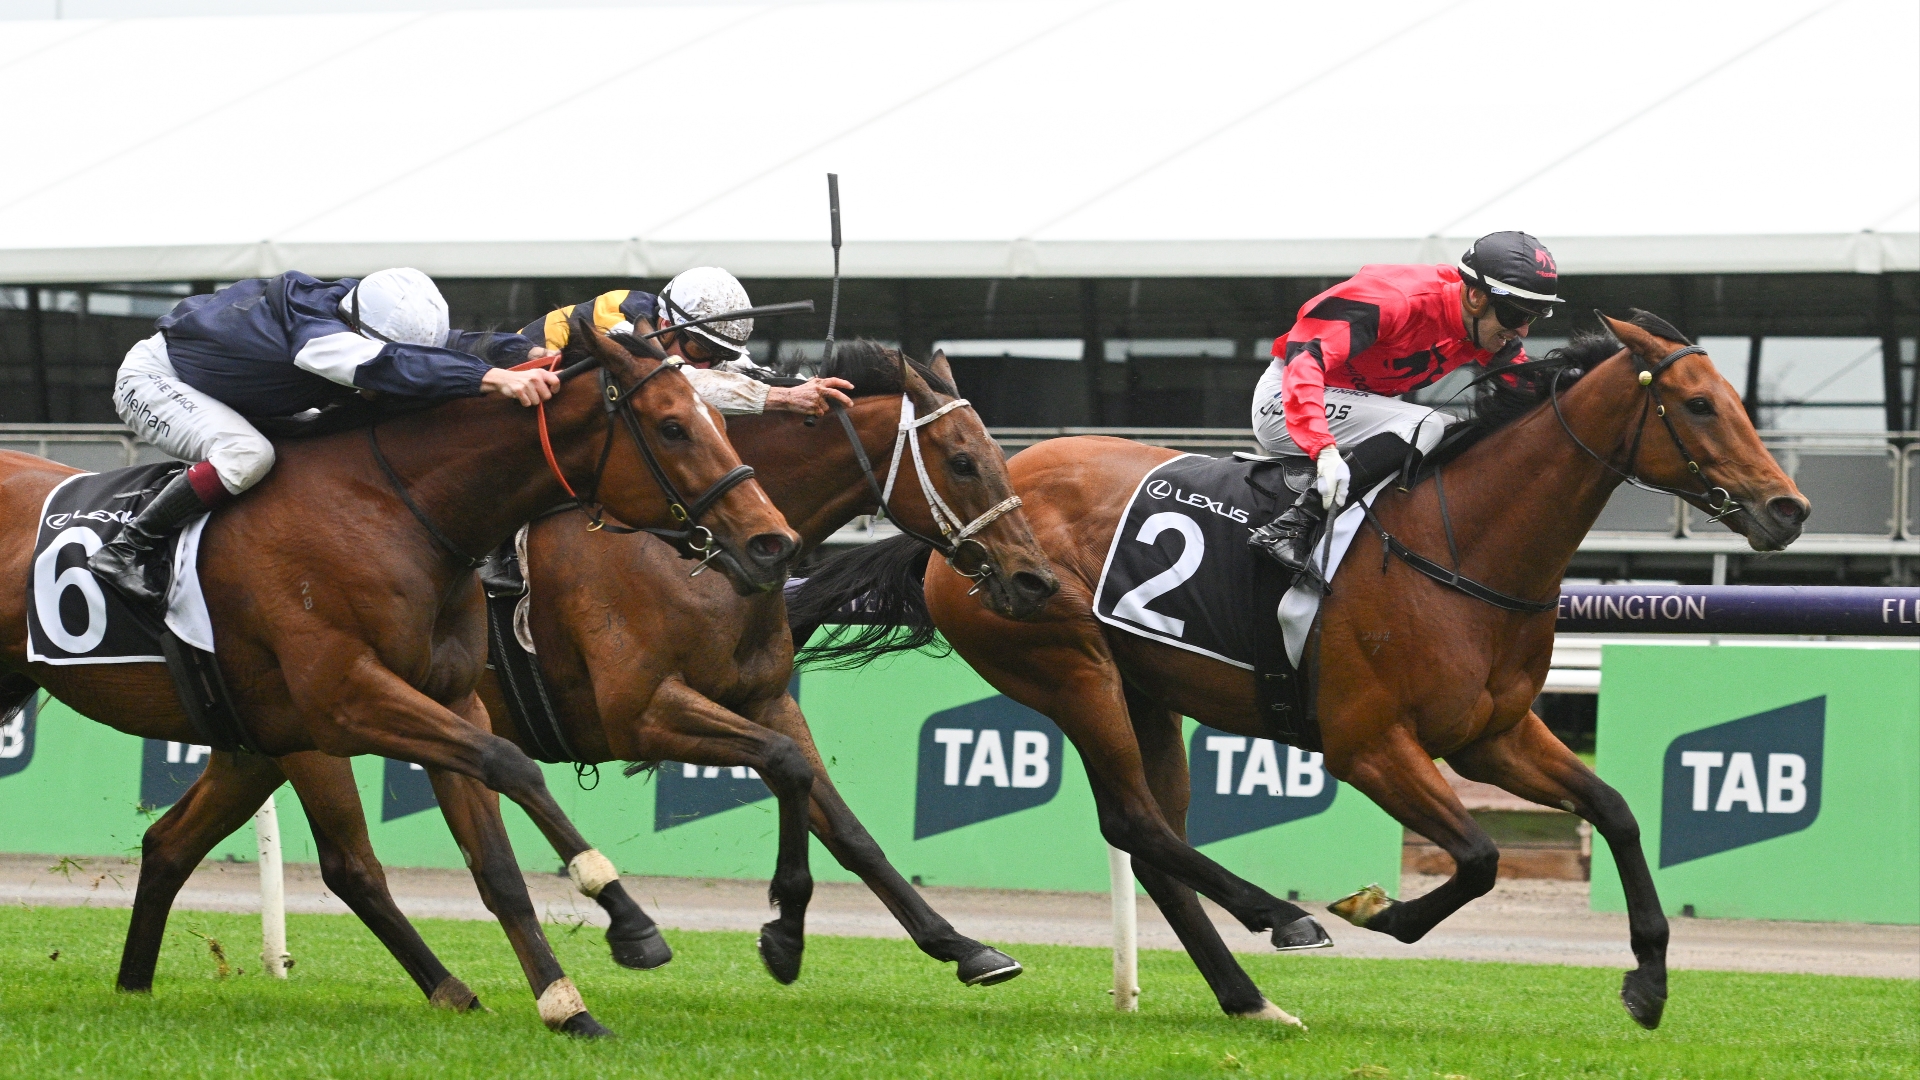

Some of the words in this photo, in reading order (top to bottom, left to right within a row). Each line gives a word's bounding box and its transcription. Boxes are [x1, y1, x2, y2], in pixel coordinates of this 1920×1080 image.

[1175, 488, 1250, 524] LEXUS
[33, 526, 108, 654] 6
[1111, 511, 1205, 638] 2
[1556, 595, 1707, 620] EMINGTON
[934, 728, 1050, 788] TAB
[1206, 735, 1325, 798] TAB
[1681, 750, 1808, 814] TAB
